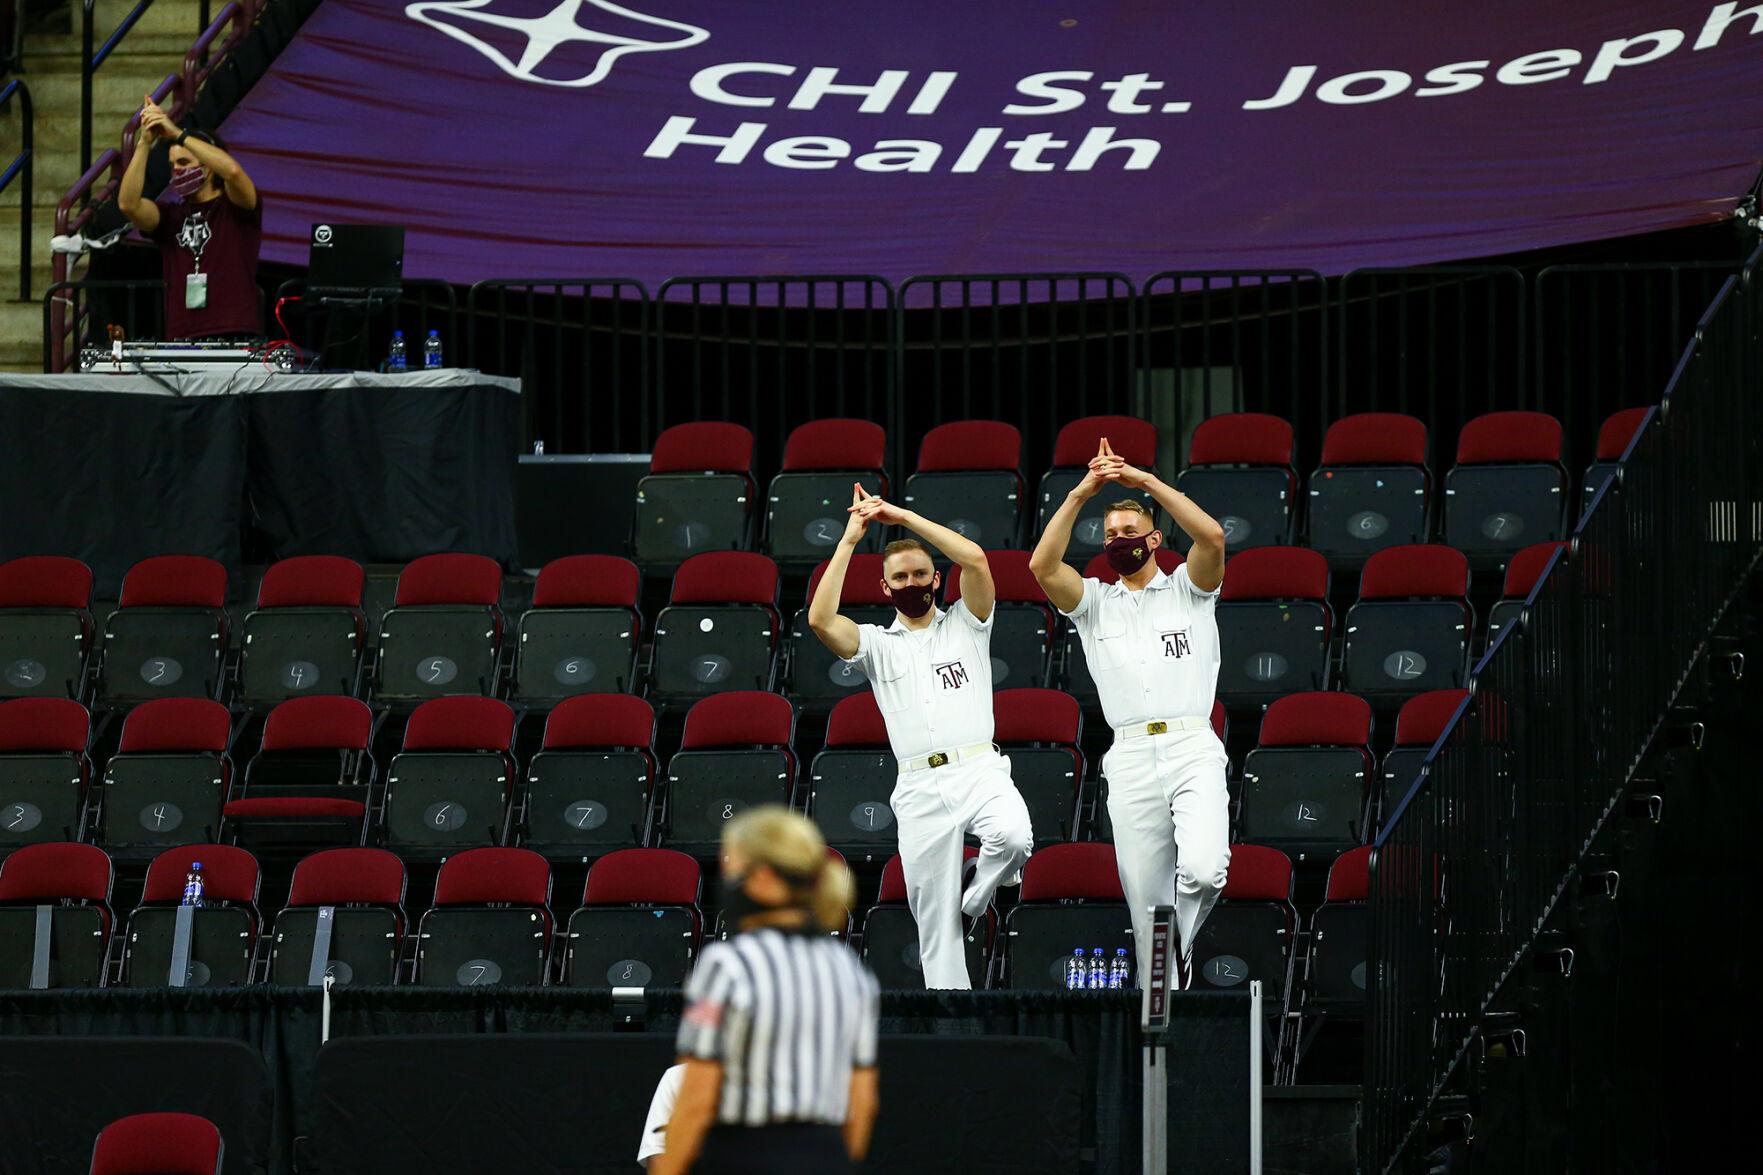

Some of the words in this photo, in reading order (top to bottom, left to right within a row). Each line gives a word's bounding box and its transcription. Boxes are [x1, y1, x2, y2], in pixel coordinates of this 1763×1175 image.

[689, 62, 958, 114] CHI
[1002, 71, 1192, 115] St.
[1242, 1, 1763, 110] Joseph
[643, 116, 1161, 173] Health
[817, 524, 834, 541] 2
[1223, 519, 1237, 538] 5
[1360, 516, 1374, 530] 6
[1494, 517, 1506, 537] 7
[148, 661, 166, 683] 3
[427, 660, 443, 682] 5
[565, 660, 580, 674] 6
[703, 661, 719, 680] 7
[1258, 657, 1273, 678] 11
[1397, 655, 1422, 677] 12
[290, 665, 304, 688] 4
[8, 805, 25, 830] 3
[153, 805, 166, 827] 4
[435, 805, 450, 825] 6
[576, 807, 593, 827] 7
[722, 804, 734, 819] 8
[864, 806, 875, 827] 9
[1297, 803, 1319, 821] 12
[470, 965, 486, 985] 7
[622, 964, 633, 980] 8
[1215, 960, 1240, 979] 12
